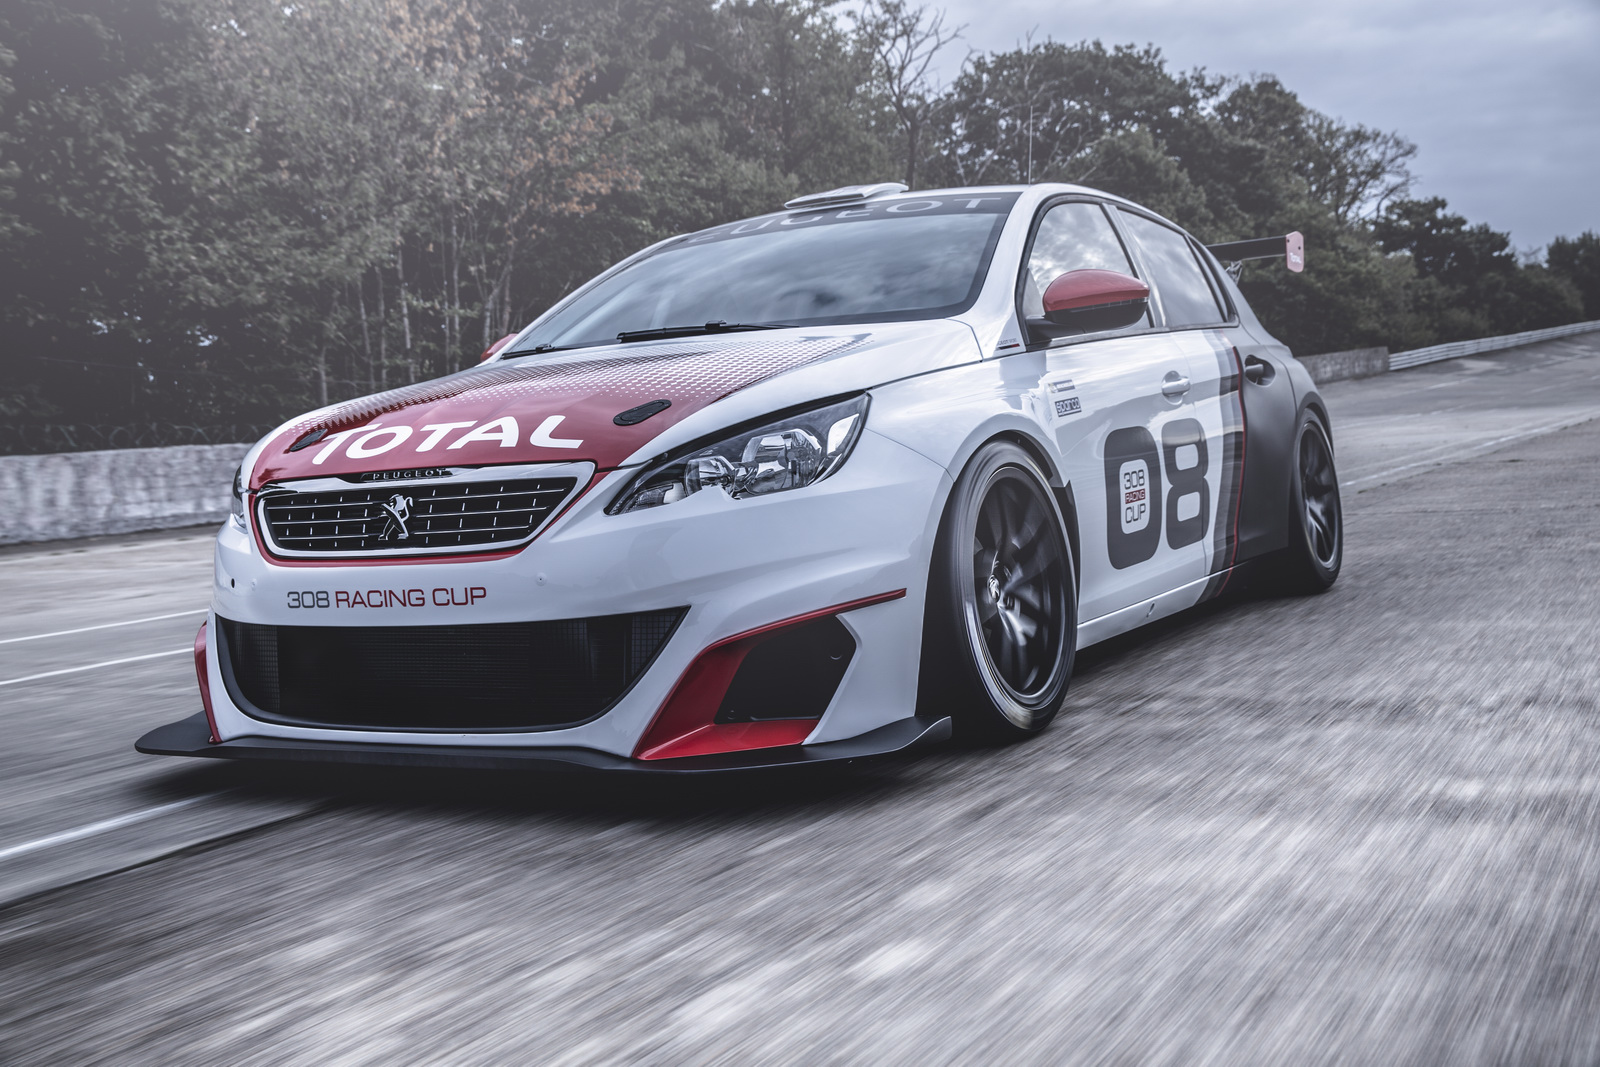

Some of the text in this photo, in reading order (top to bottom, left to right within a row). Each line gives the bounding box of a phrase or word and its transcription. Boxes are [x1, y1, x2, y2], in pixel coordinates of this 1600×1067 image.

[1056, 398, 1080, 414] sparco
[312, 415, 583, 464] TOTAL
[373, 468, 446, 480] PEUGEOT
[1124, 469, 1145, 489] 308
[1104, 418, 1210, 570] 08
[1125, 490, 1145, 503] RACING
[1125, 503, 1146, 523] CUP
[287, 587, 487, 609] 308 RACING CUP
